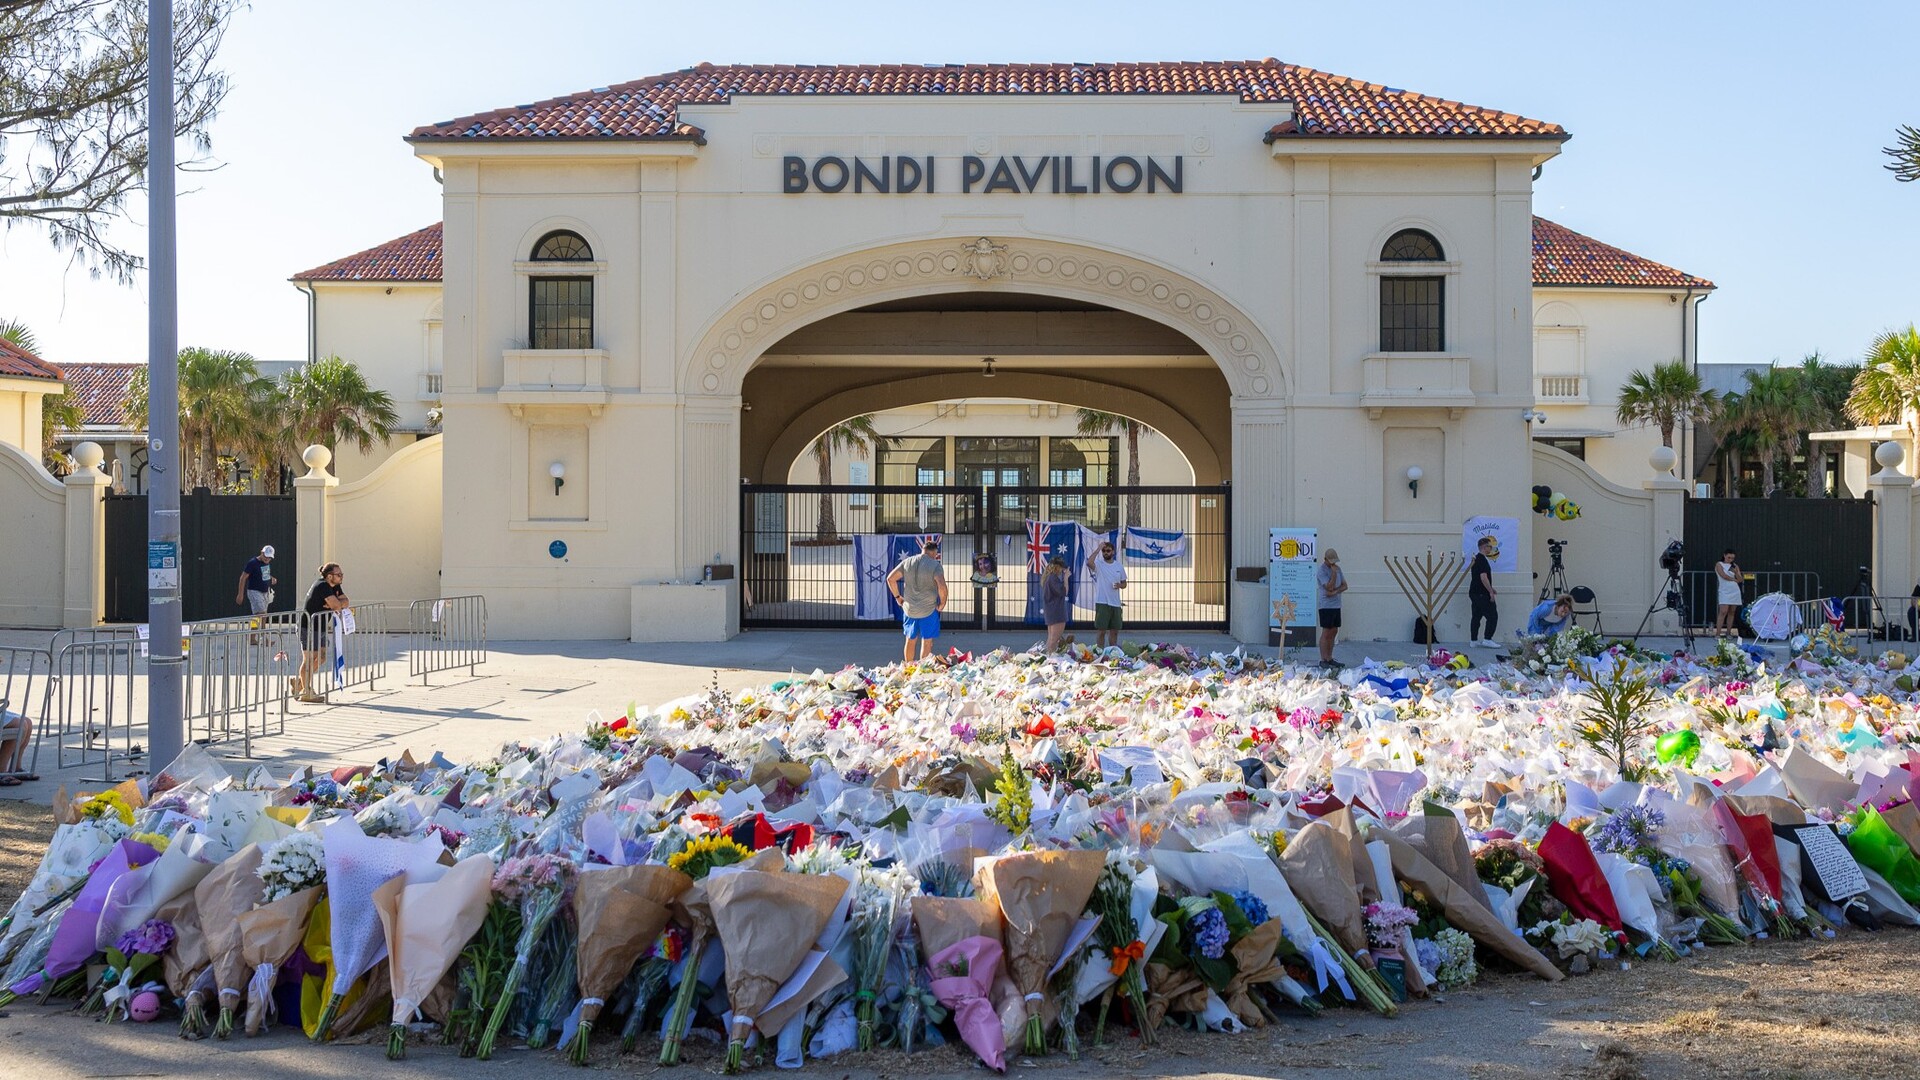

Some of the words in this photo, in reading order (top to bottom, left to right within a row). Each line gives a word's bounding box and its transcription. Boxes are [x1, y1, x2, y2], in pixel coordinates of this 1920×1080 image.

[783, 155, 934, 194] BONDI
[962, 155, 1183, 194] PAVILION
[1472, 523, 1500, 534] Matilda
